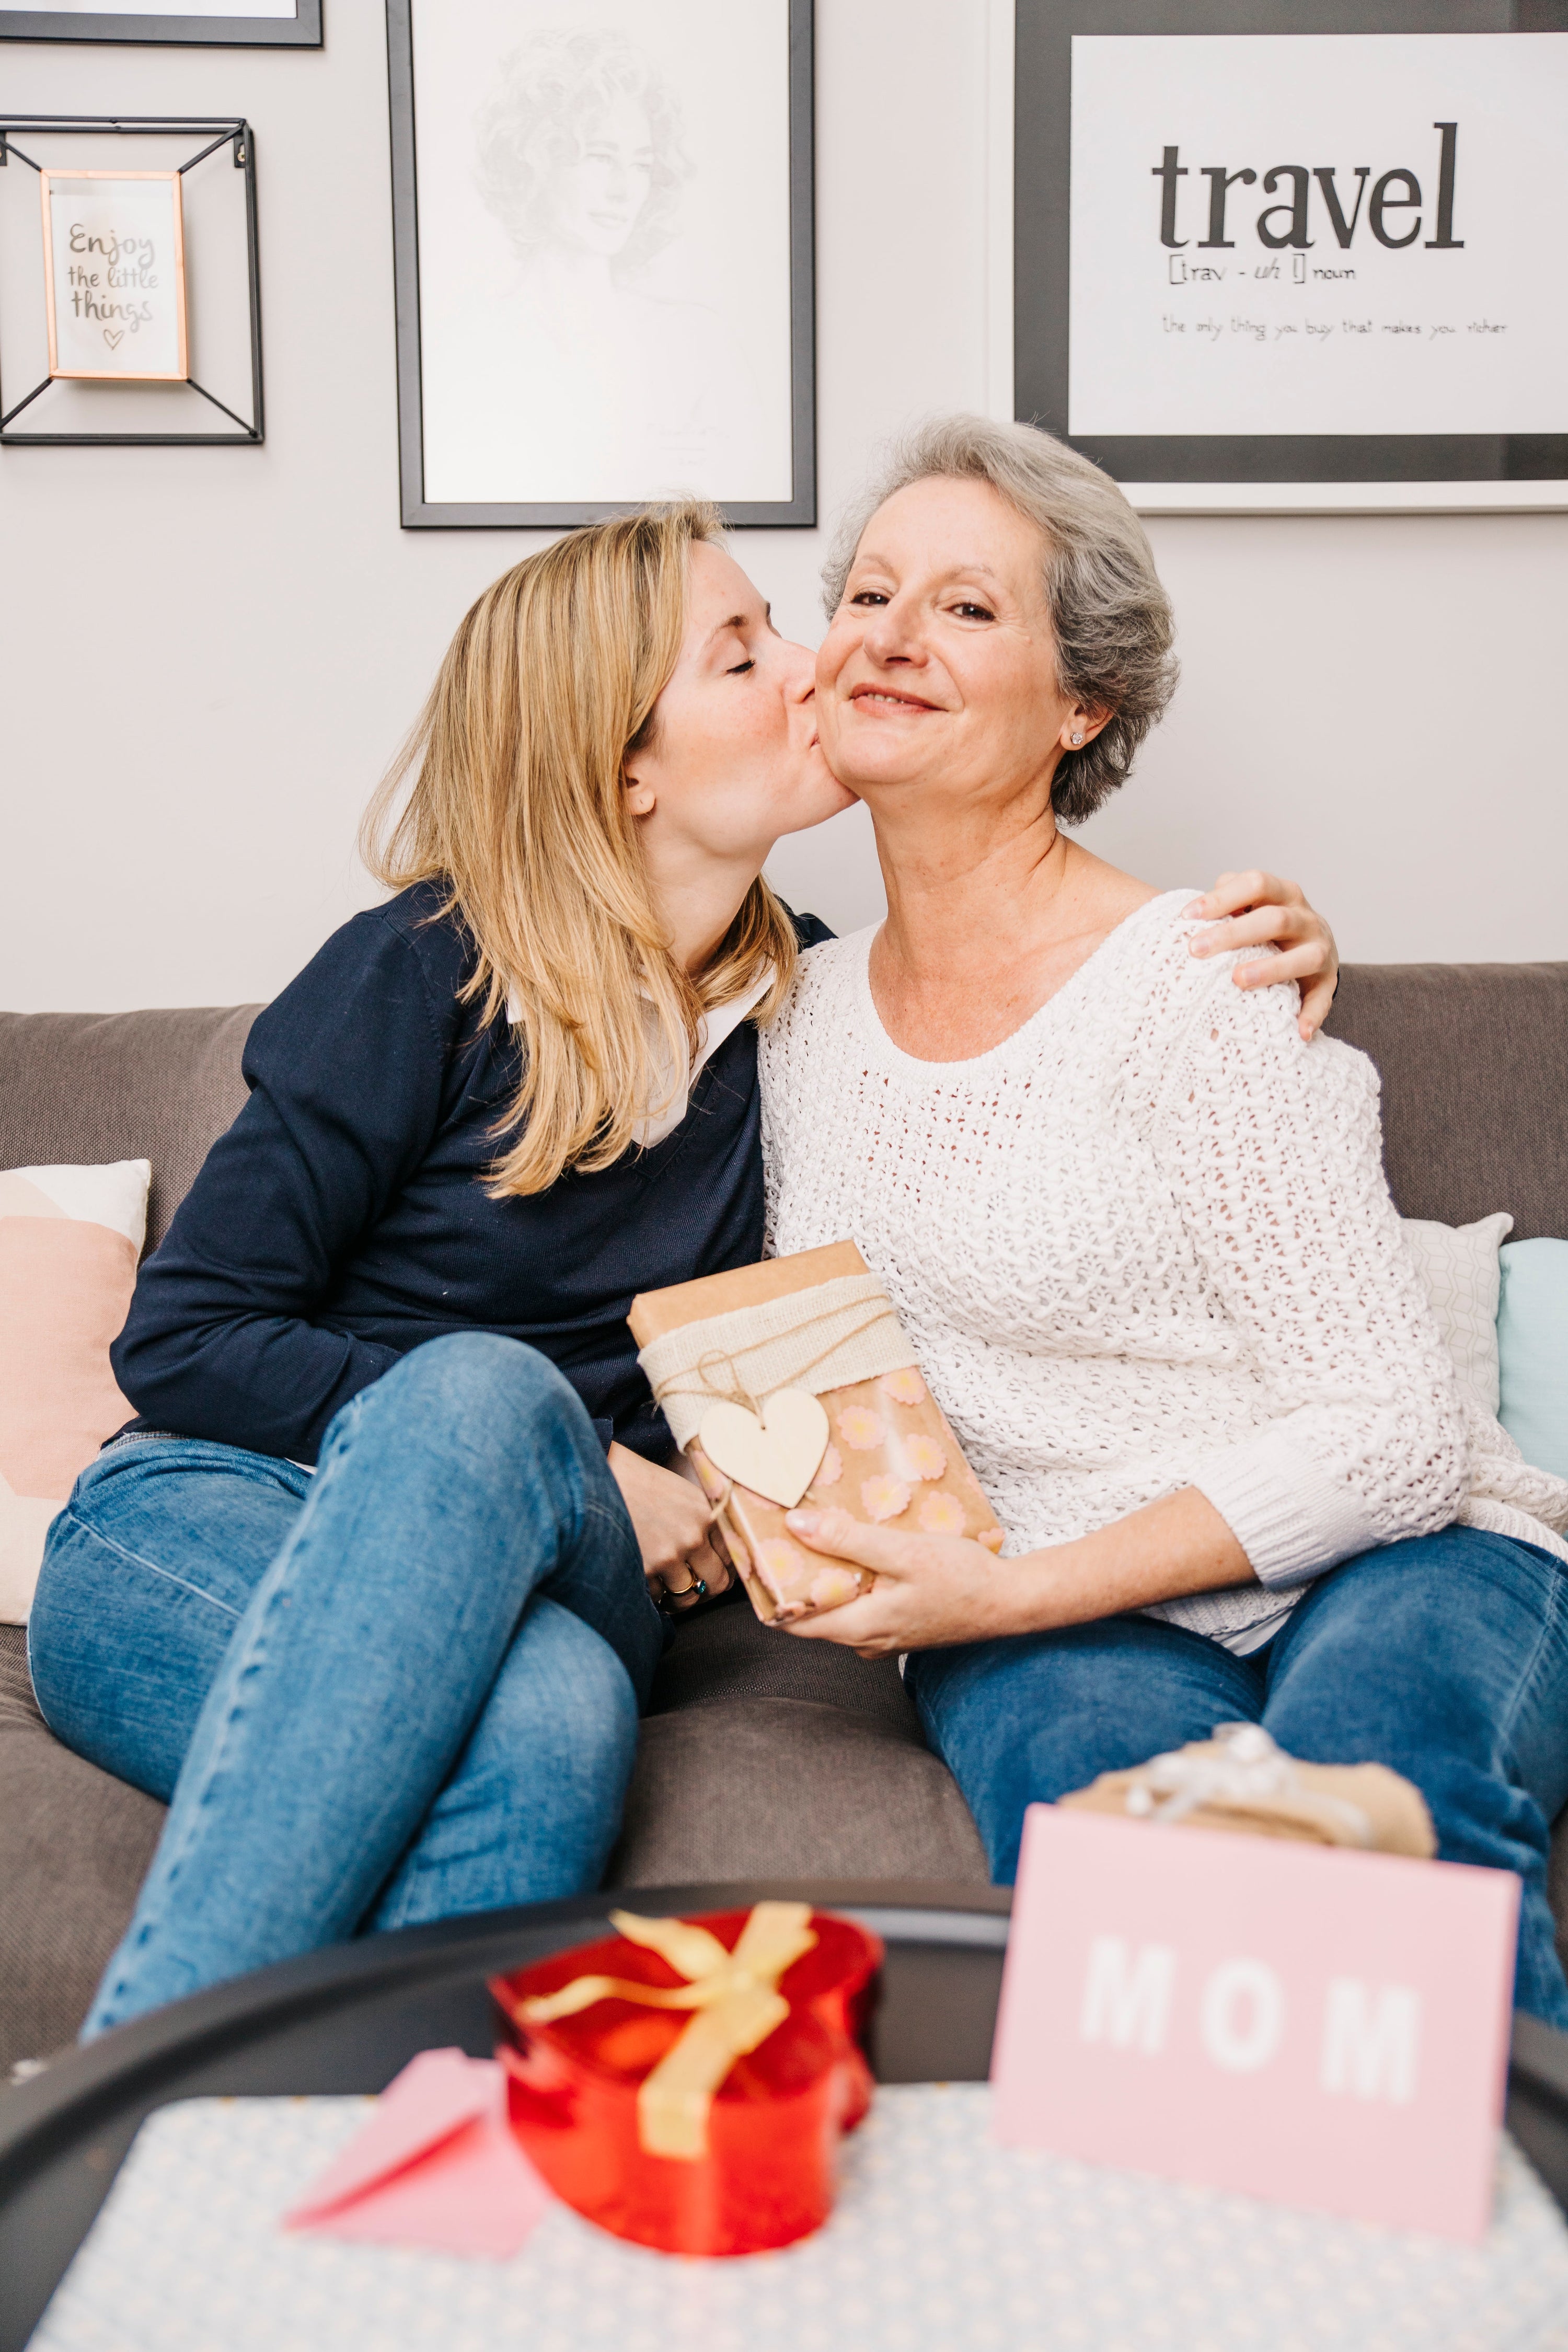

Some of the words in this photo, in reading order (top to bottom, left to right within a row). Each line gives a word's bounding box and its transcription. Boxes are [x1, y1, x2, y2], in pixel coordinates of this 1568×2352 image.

[1151, 122, 1465, 249] travel
[69, 223, 155, 269] Enjoy
[68, 266, 100, 289] the
[108, 267, 159, 289] little
[1313, 267, 1356, 280] noun
[71, 290, 153, 333] things
[1163, 315, 1186, 334] the
[1196, 316, 1224, 341] only
[1231, 315, 1266, 341] thing
[1275, 322, 1298, 340] you
[1305, 317, 1335, 341] buy
[1343, 316, 1373, 334] that
[1381, 319, 1422, 334] makes
[1430, 322, 1458, 340] you
[1467, 317, 1508, 334] richer
[1081, 1935, 1421, 2104] MOM
